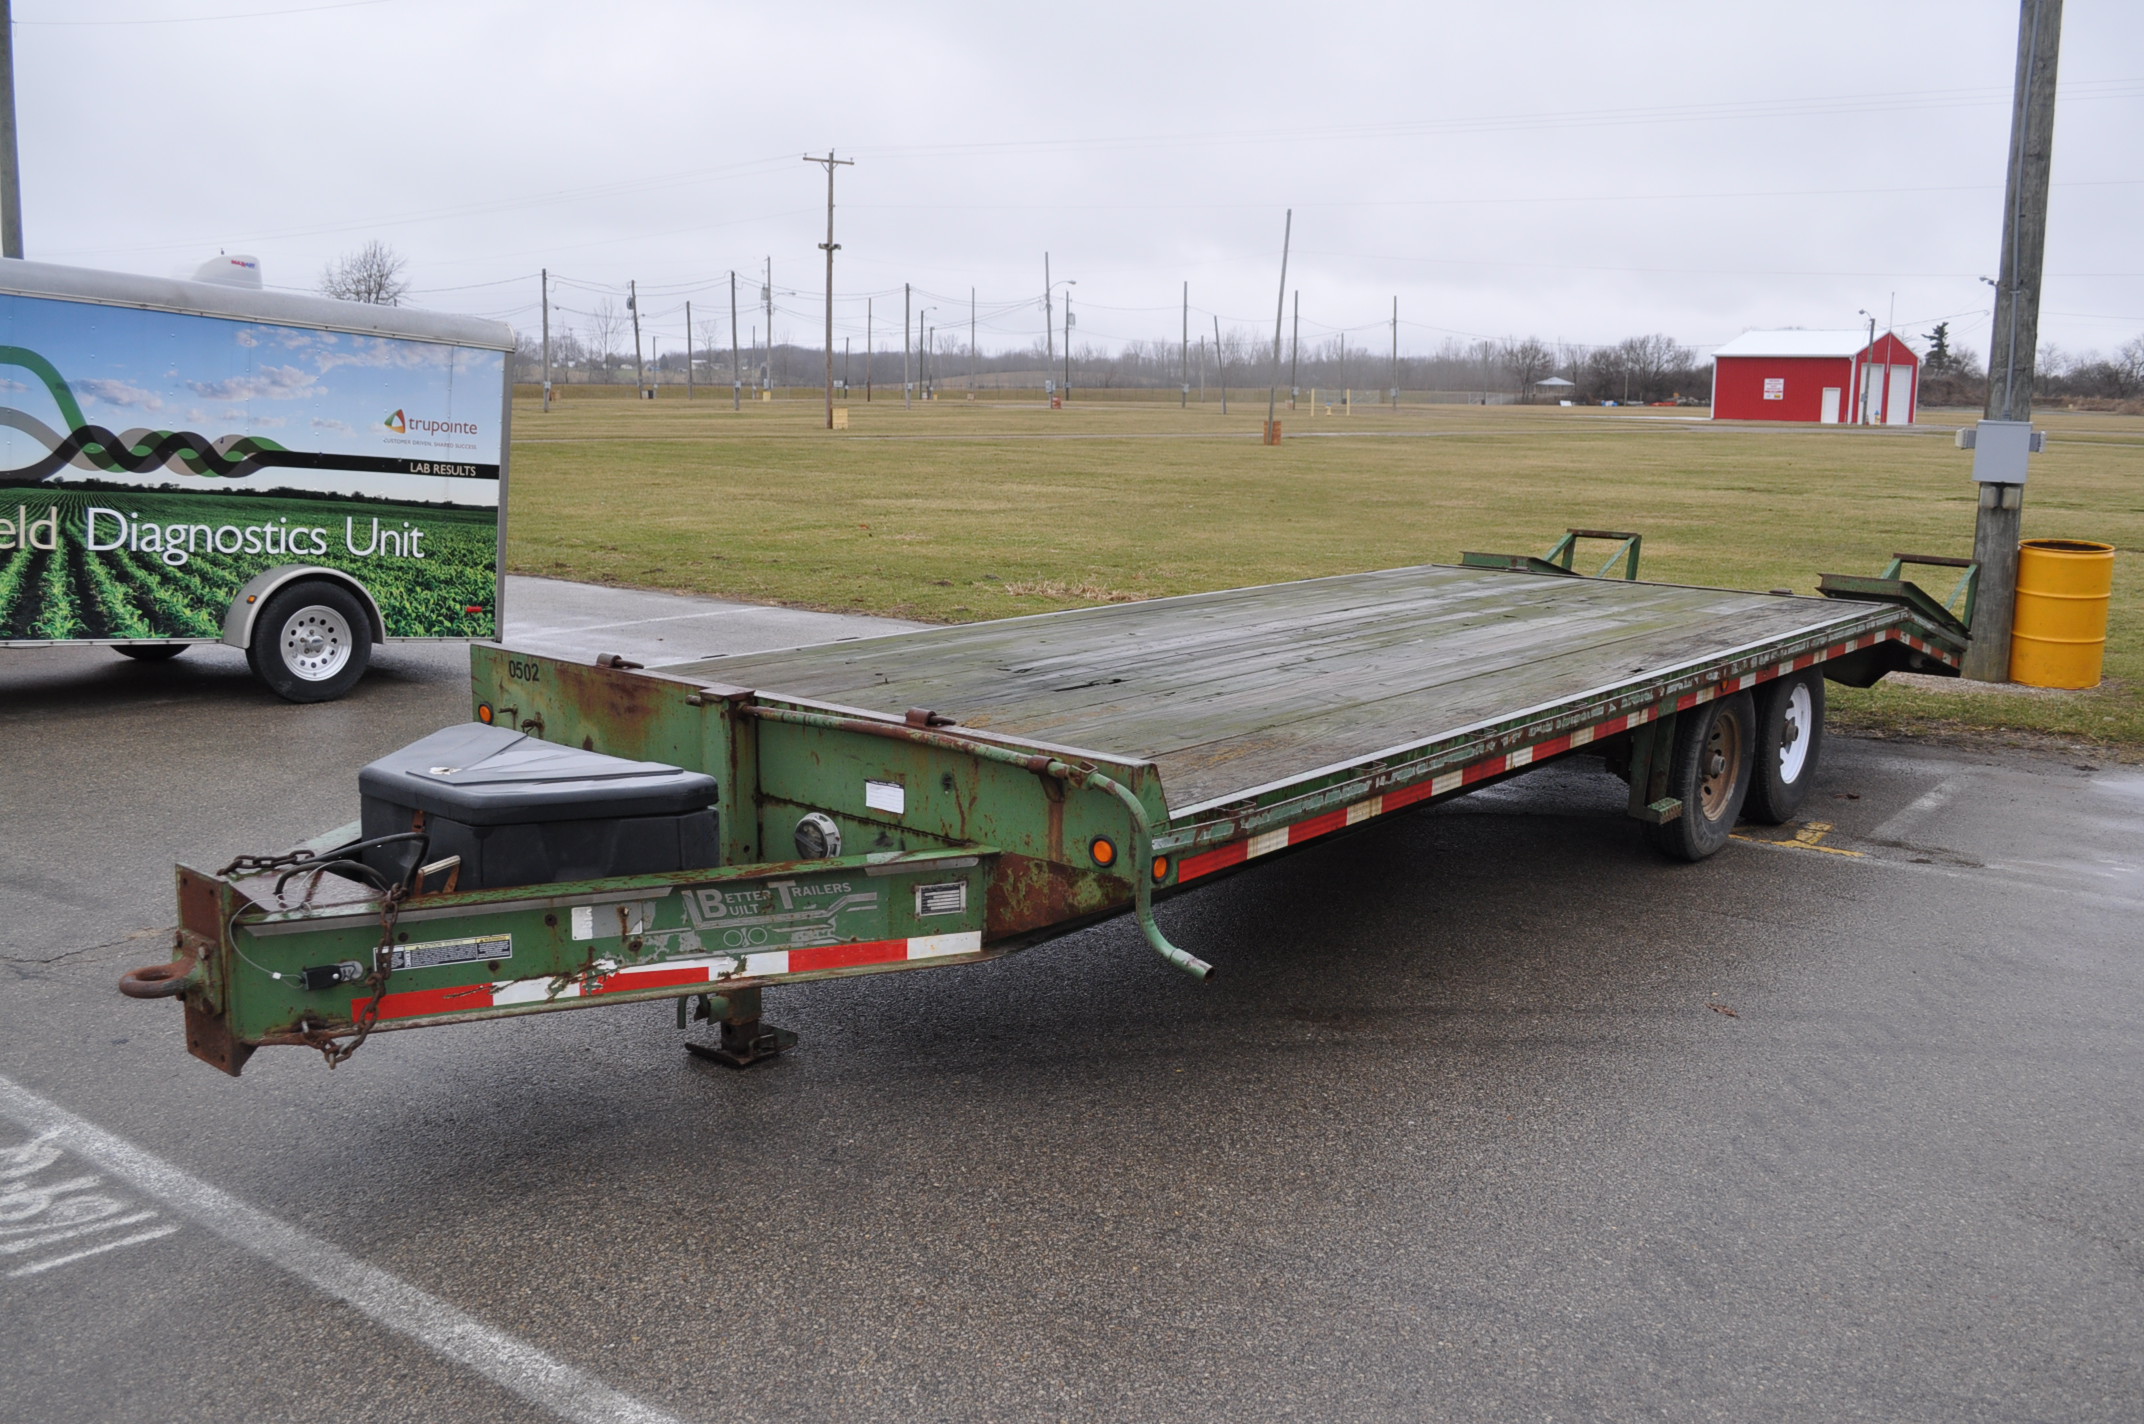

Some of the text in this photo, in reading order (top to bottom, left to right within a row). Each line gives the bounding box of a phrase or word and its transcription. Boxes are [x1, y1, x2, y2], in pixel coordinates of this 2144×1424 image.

[409, 418, 478, 436] trupointe
[410, 462, 476, 476] LAB RESULTS
[87, 507, 327, 566] Diagnostics
[345, 516, 425, 558] Unit
[509, 660, 540, 681] 0502
[767, 880, 851, 909] TRAILERS
